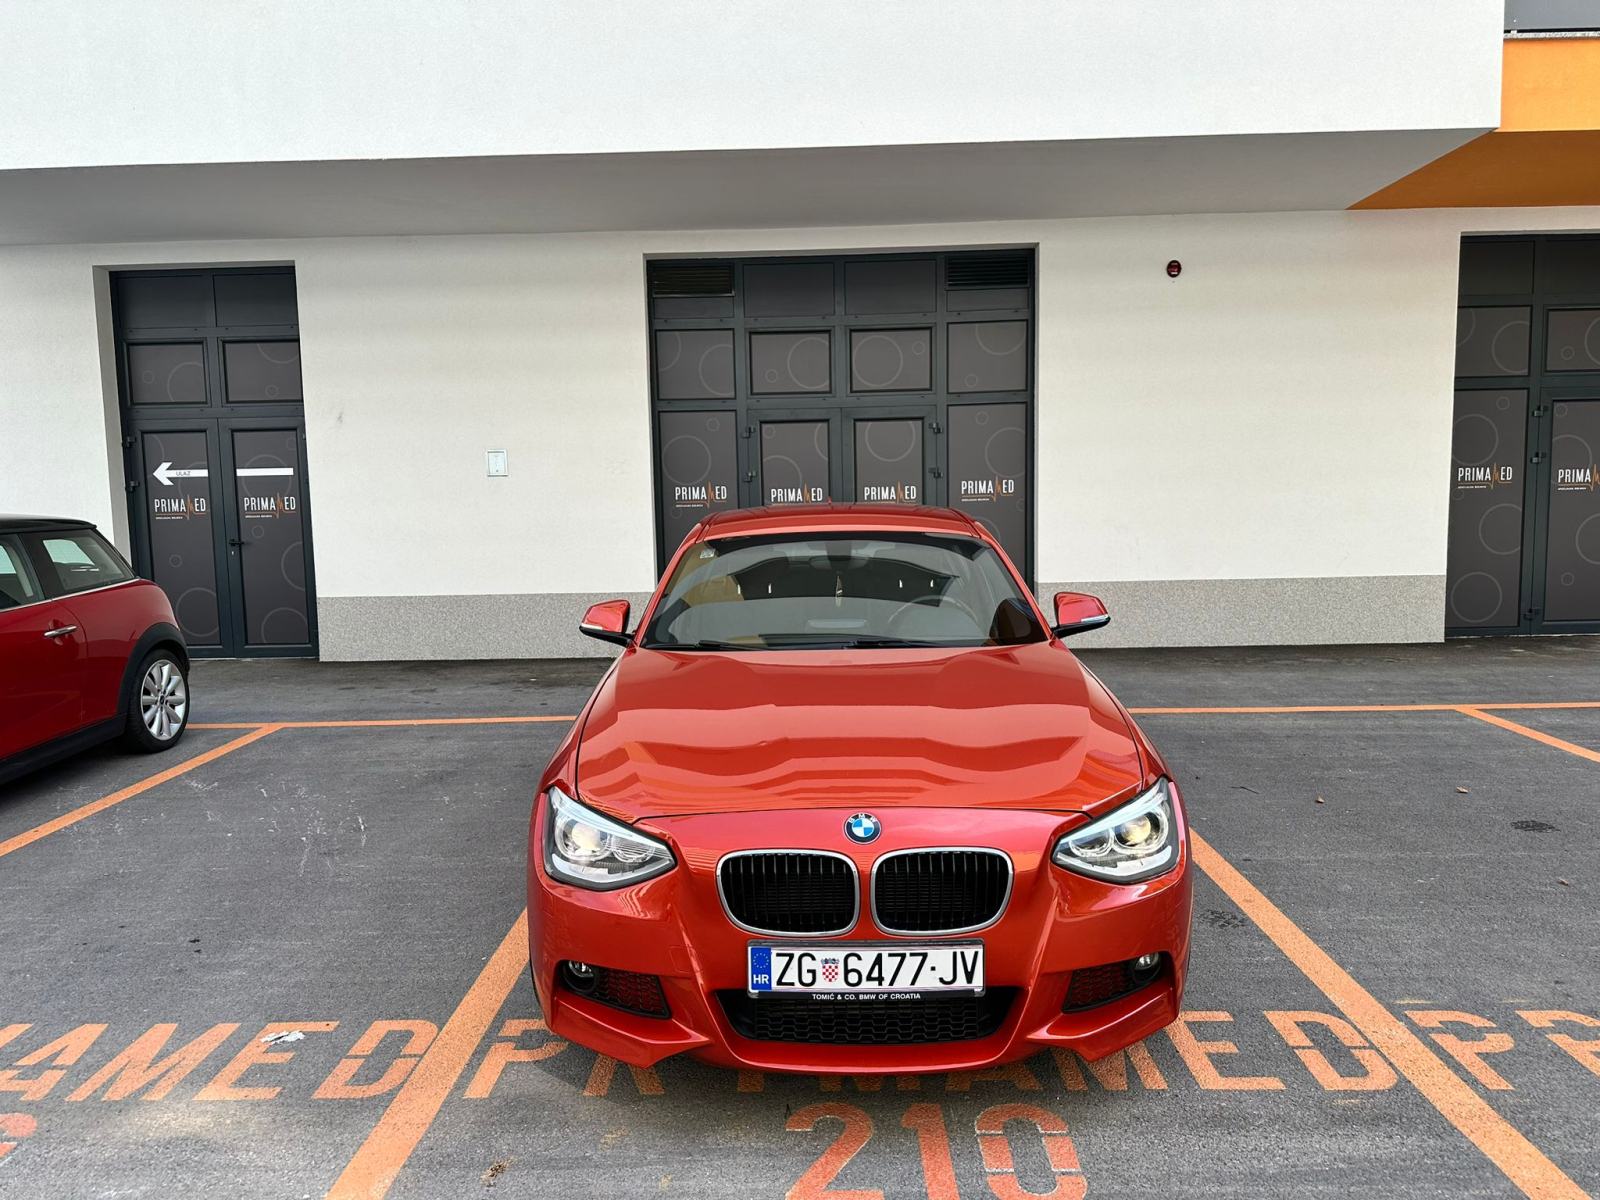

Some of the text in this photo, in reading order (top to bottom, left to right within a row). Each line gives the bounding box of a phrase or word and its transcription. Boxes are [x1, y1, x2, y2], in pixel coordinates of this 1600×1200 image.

[753, 974, 770, 985] HR
[775, 952, 817, 987] ZG
[785, 1103, 1088, 1200] 210
